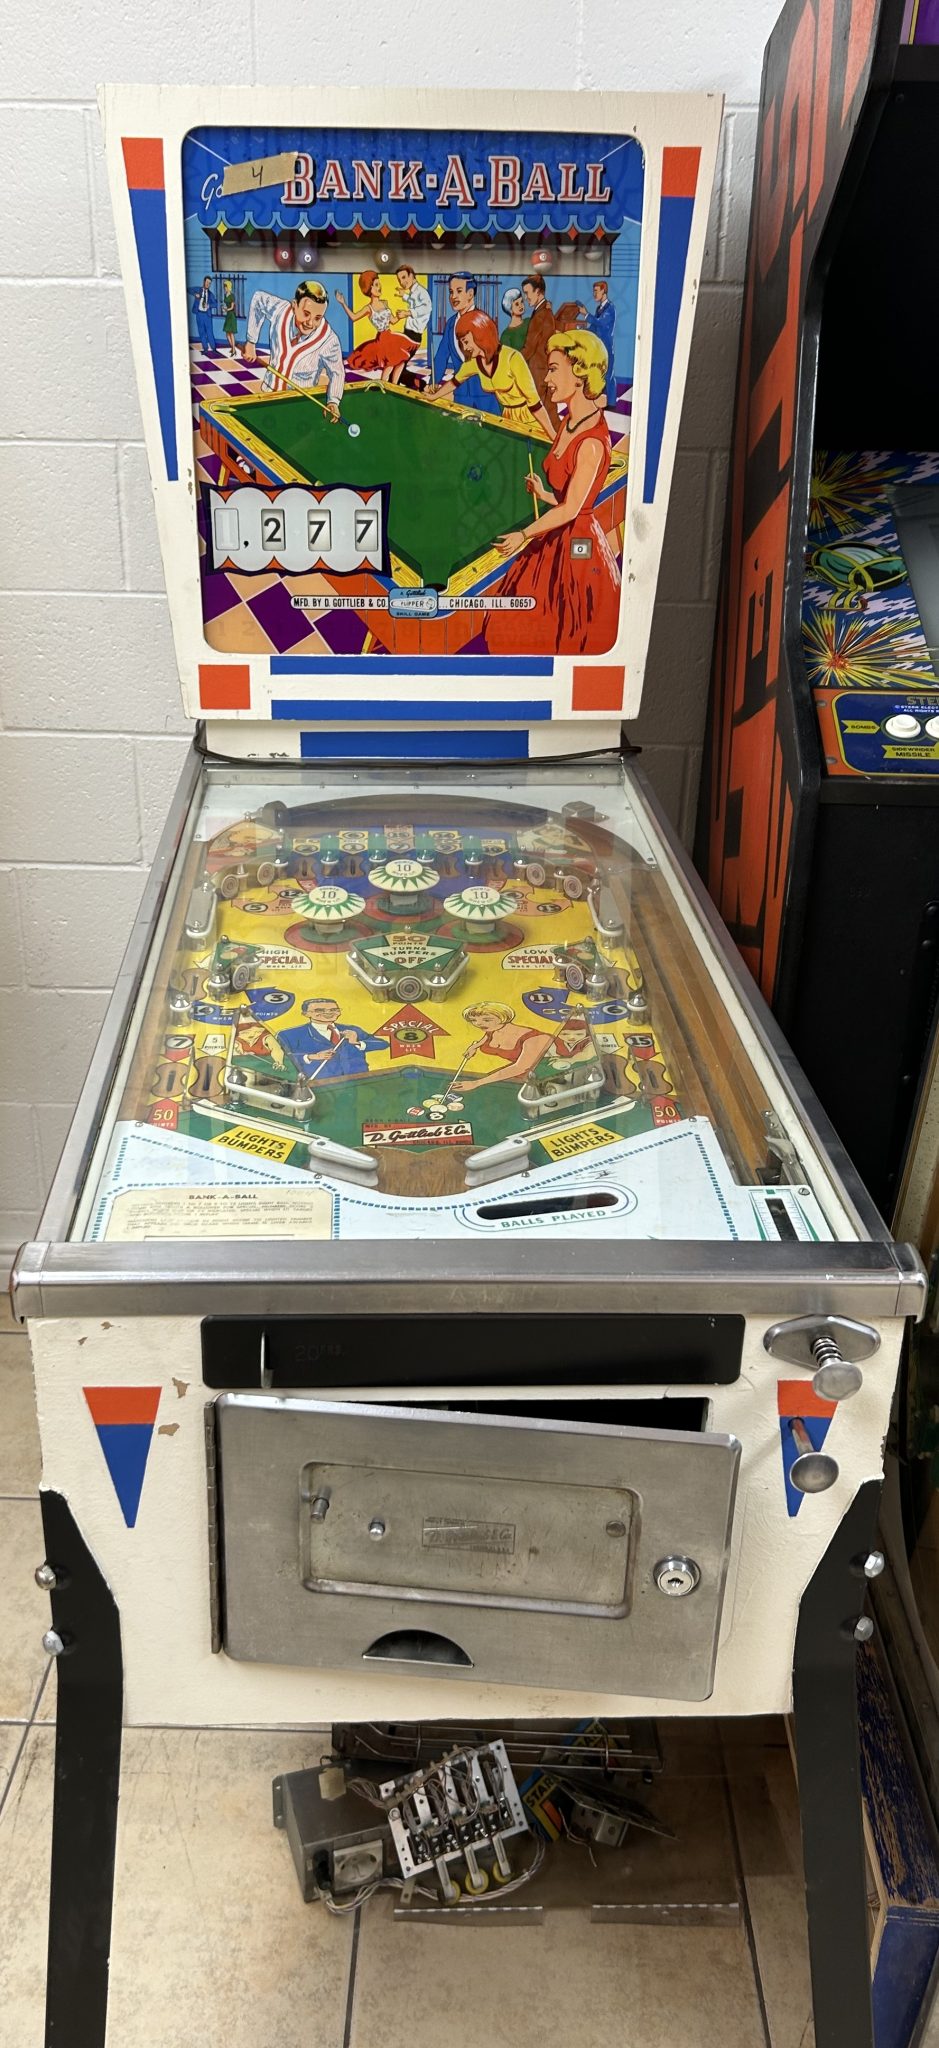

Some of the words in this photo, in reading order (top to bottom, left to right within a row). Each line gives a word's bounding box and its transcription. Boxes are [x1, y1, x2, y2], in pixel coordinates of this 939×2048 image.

[251, 165, 264, 186] 4
[293, 598, 310, 607] MFD.
[313, 598, 321, 607] BY
[325, 598, 331, 607] D.
[333, 598, 365, 608] GOTTLIEB
[369, 598, 374, 607] &
[401, 600, 425, 608] FLIPPER
[510, 598, 532, 608] 60651
[397, 864, 411, 872] 10
[322, 890, 337, 899] 10
[474, 891, 489, 899] 10
[259, 956, 307, 964] SPECIAL
[383, 1020, 440, 1034] SPECIAL
[404, 1032, 419, 1041] 8
[631, 1037, 651, 1045] 15
[153, 1109, 174, 1121] 50
[654, 1106, 676, 1118] 50
[235, 1131, 287, 1149] LIGHTS
[365, 1132, 386, 1142] D.
[388, 1127, 443, 1143] Gottlieb
[550, 1128, 600, 1147] LIGHTS
[218, 1136, 285, 1159] BUMPERS
[551, 1132, 615, 1158] BUMPERS
[501, 1217, 545, 1229] BALLS
[552, 1210, 607, 1222] PLAYED
